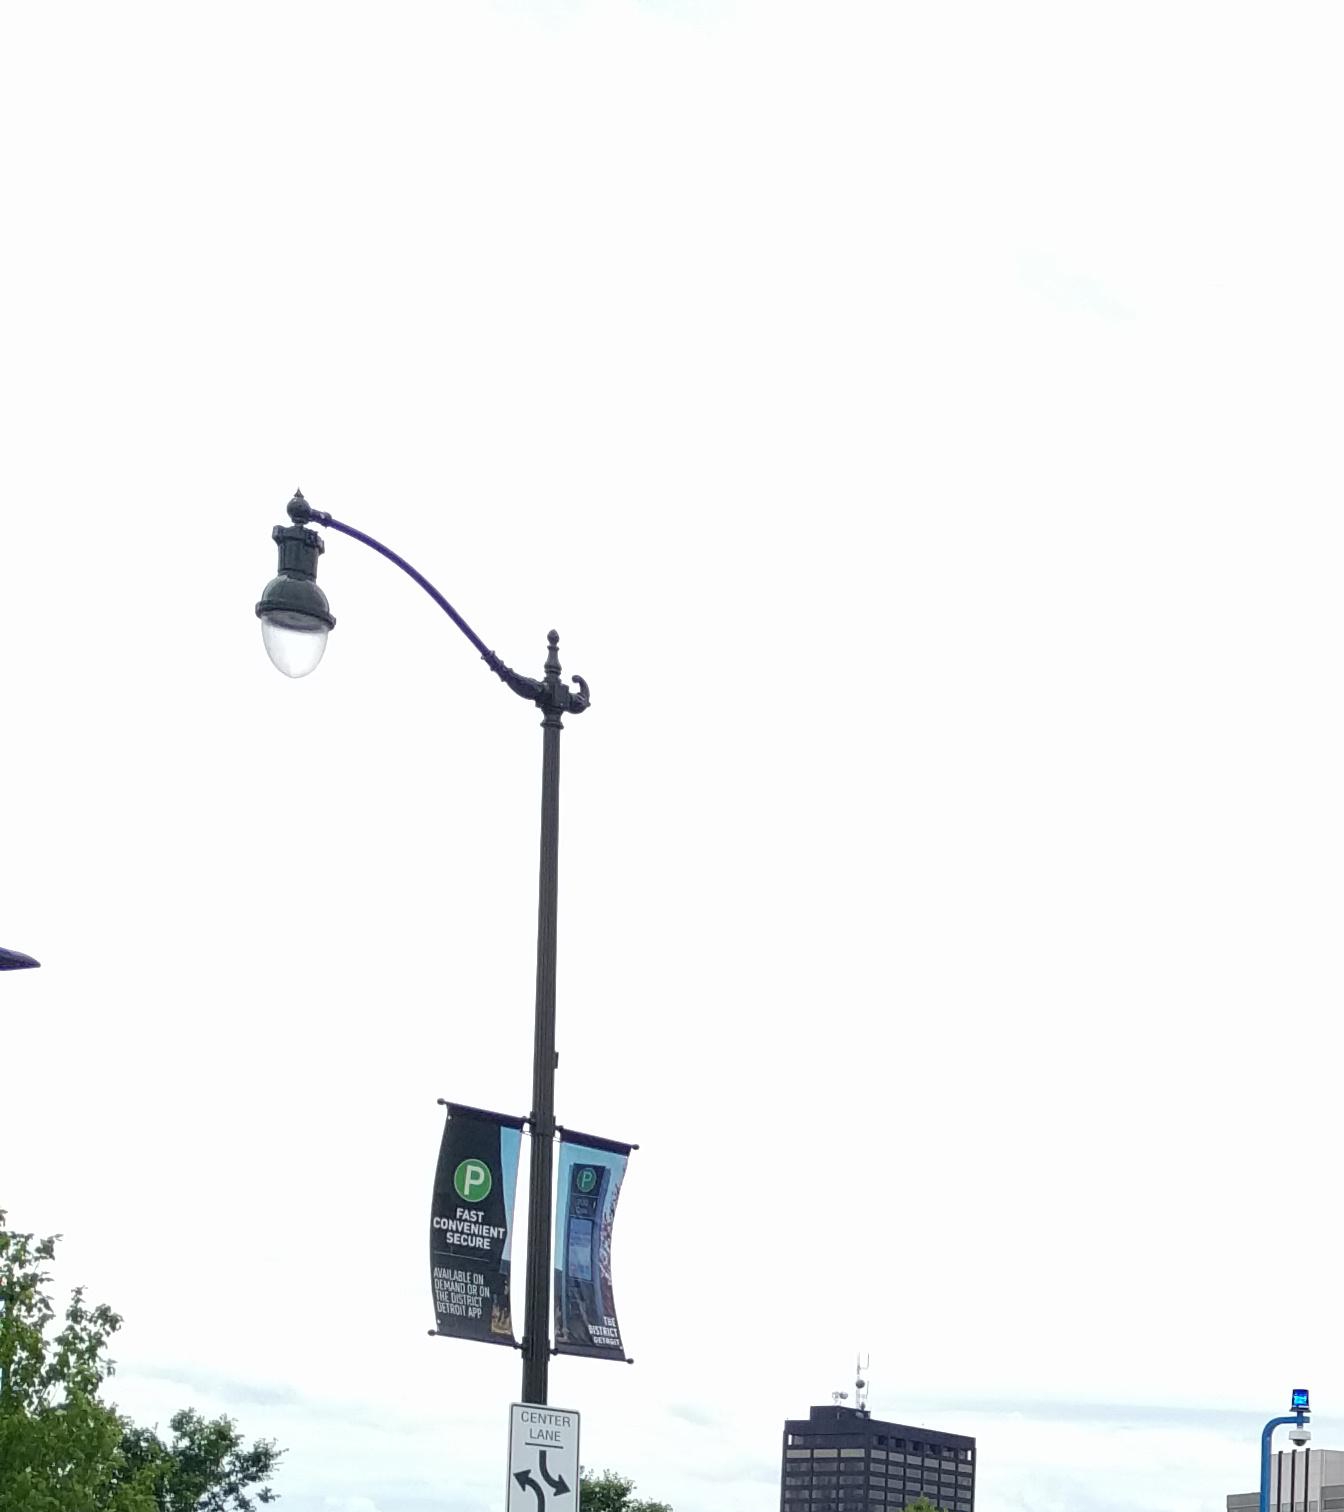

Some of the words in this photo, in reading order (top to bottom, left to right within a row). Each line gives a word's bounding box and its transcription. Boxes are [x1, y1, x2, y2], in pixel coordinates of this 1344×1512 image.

[464, 1165, 485, 1195] P
[581, 1170, 592, 1188] P
[456, 1207, 485, 1222] FAST
[433, 1216, 505, 1239] CONVENIENT
[446, 1232, 491, 1249] SECURE
[433, 1267, 471, 1283] AVAILABLE
[473, 1274, 484, 1285] ON
[434, 1278, 466, 1294] DEMAND
[467, 1284, 478, 1296] OR
[480, 1286, 490, 1298] ON
[436, 1290, 449, 1302] THE
[451, 1292, 482, 1307] DISTRICT
[437, 1301, 466, 1316] DETROIT
[468, 1306, 482, 1318] APP
[521, 1411, 571, 1427] CENTER
[529, 1428, 561, 1442] LANE
